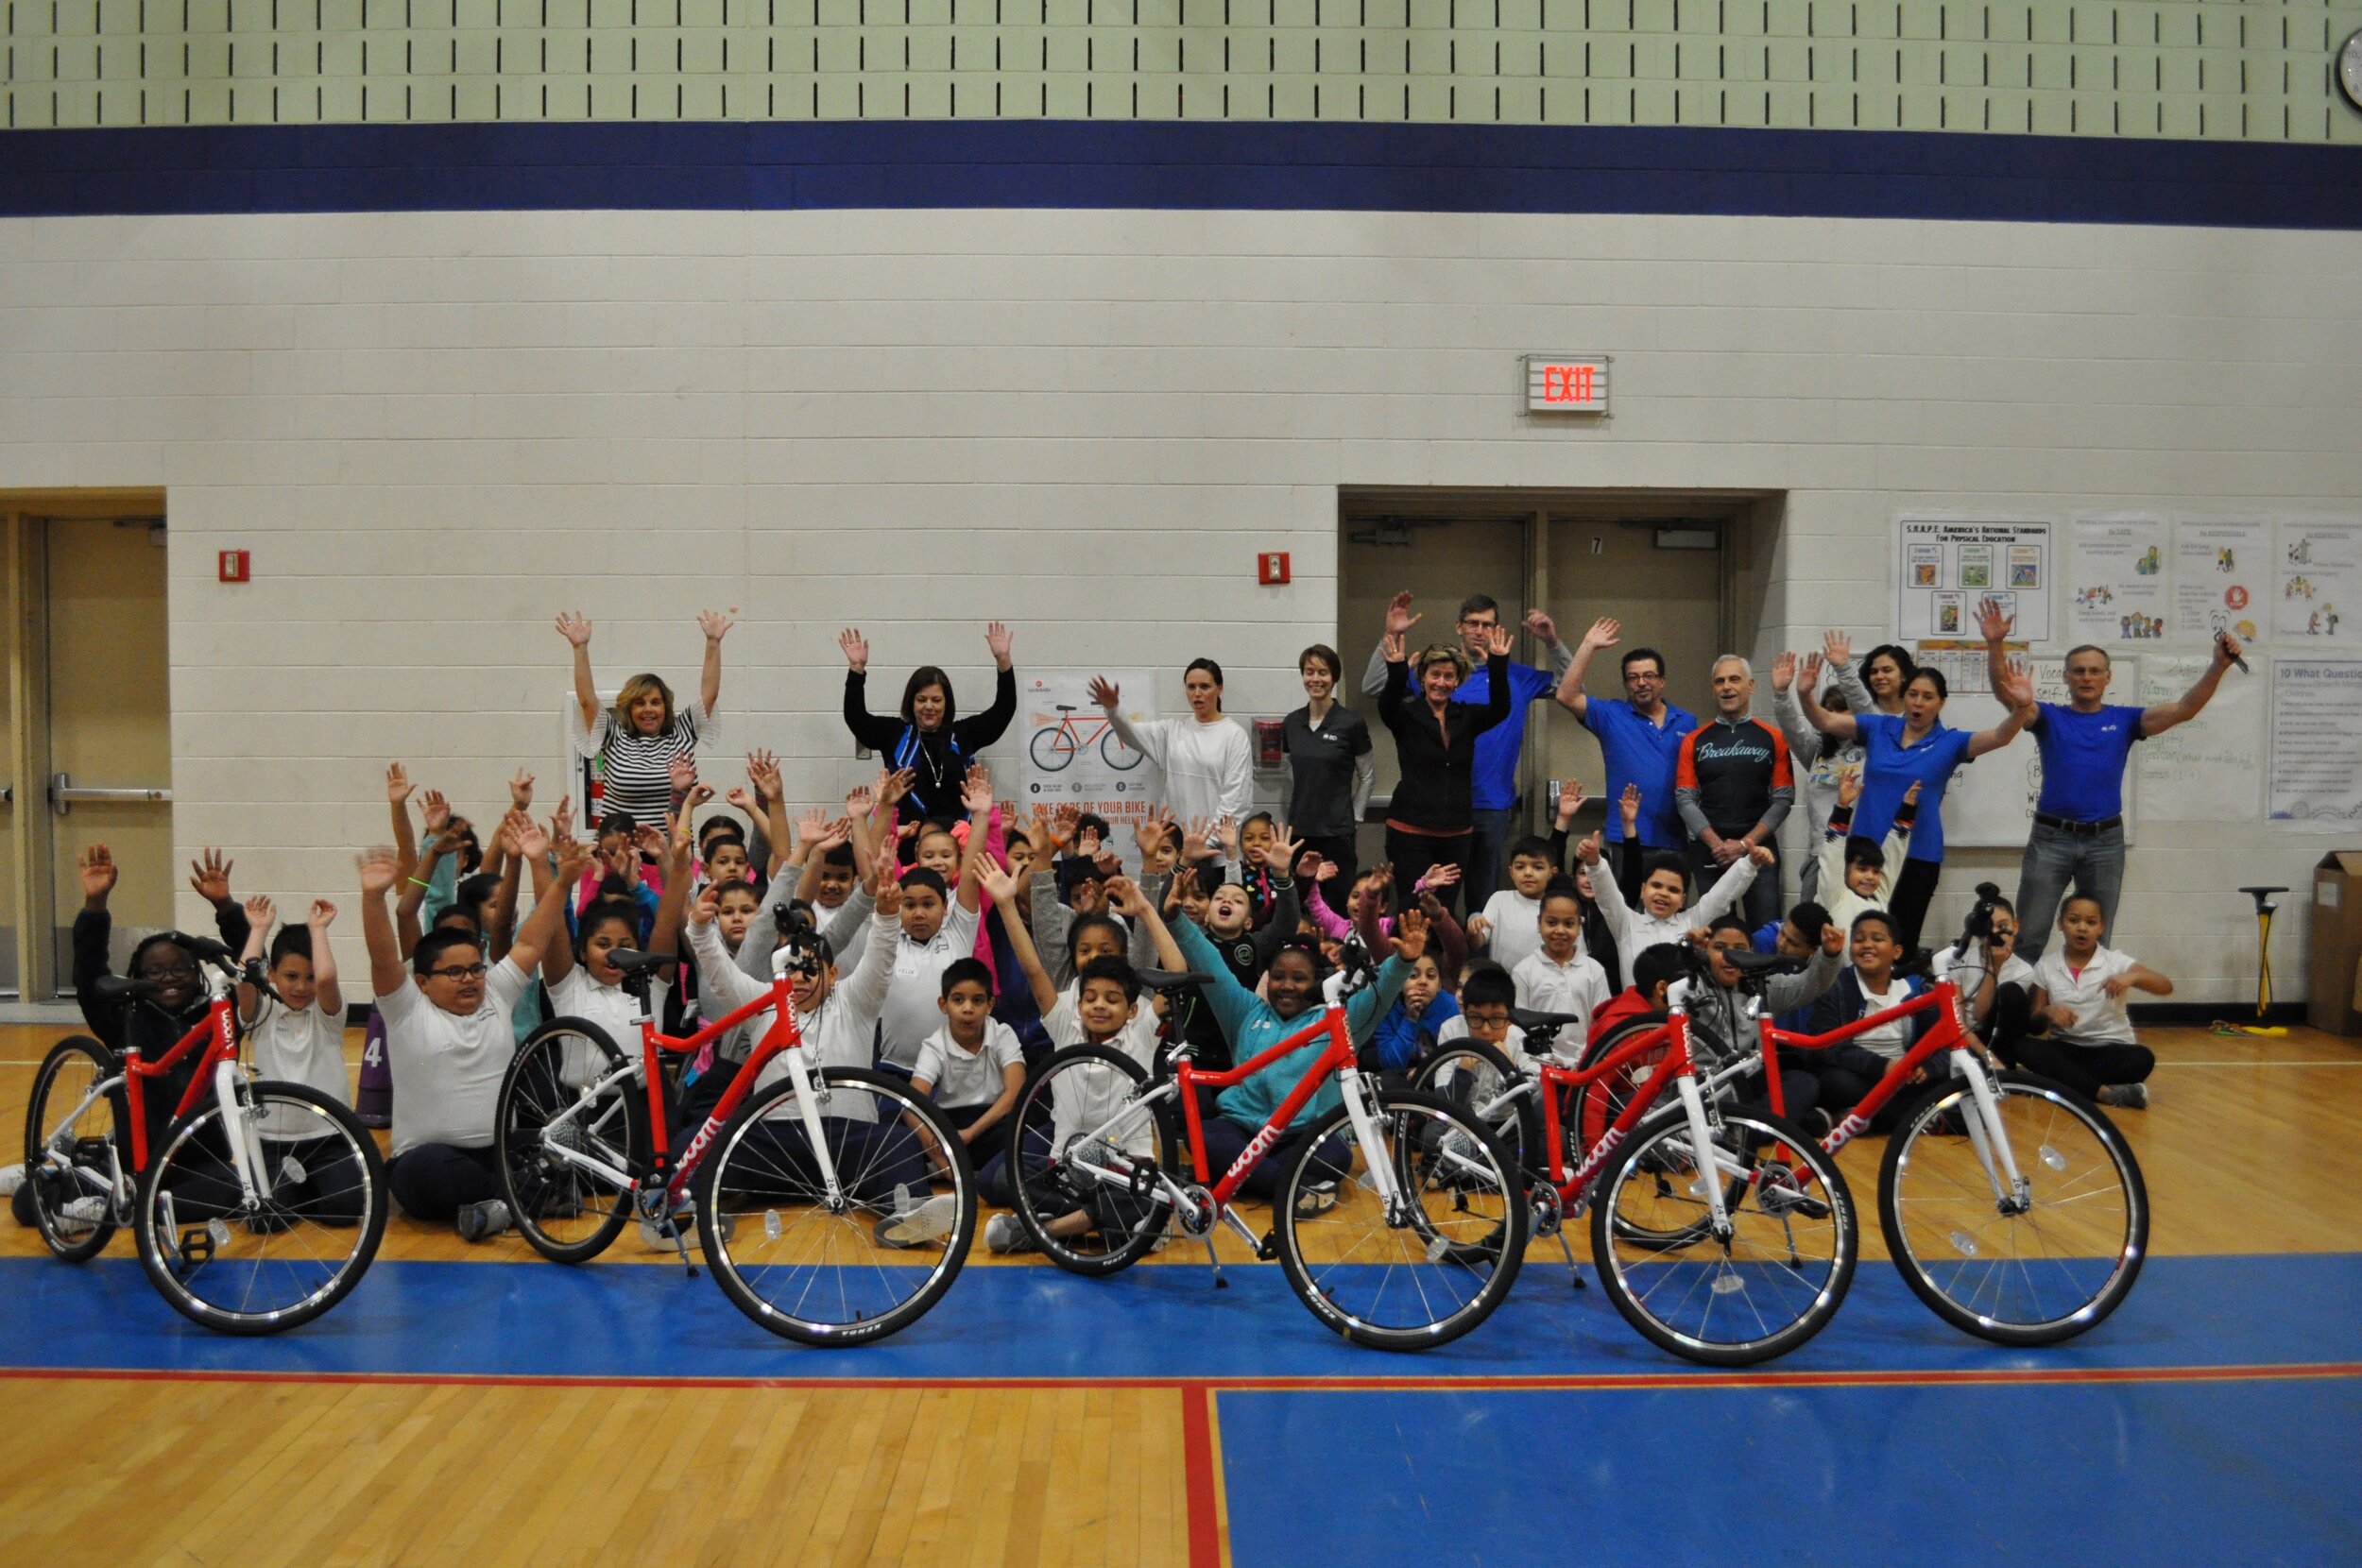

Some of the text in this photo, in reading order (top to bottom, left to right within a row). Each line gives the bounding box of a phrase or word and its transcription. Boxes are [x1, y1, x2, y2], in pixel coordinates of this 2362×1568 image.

[1544, 366, 1596, 403] EXIT
[1594, 537, 1601, 554] 7
[2281, 669, 2291, 678] 10
[2294, 669, 2319, 678] What
[1697, 739, 1772, 765] Breakaway
[1083, 802, 1095, 814] OF
[1098, 801, 1122, 813] YOUR
[1124, 800, 1147, 813] BIKE
[785, 990, 798, 1034] woom
[221, 1007, 234, 1051] woom
[364, 1037, 383, 1068] 4
[1227, 1124, 1285, 1178] woom
[1575, 1126, 1627, 1178] woom
[827, 1177, 835, 1190] 26
[1381, 1193, 1391, 1205] 24
[1715, 1202, 1725, 1216] 24
[1306, 1288, 1337, 1321] KENDA
[841, 1322, 881, 1337] KENDA
